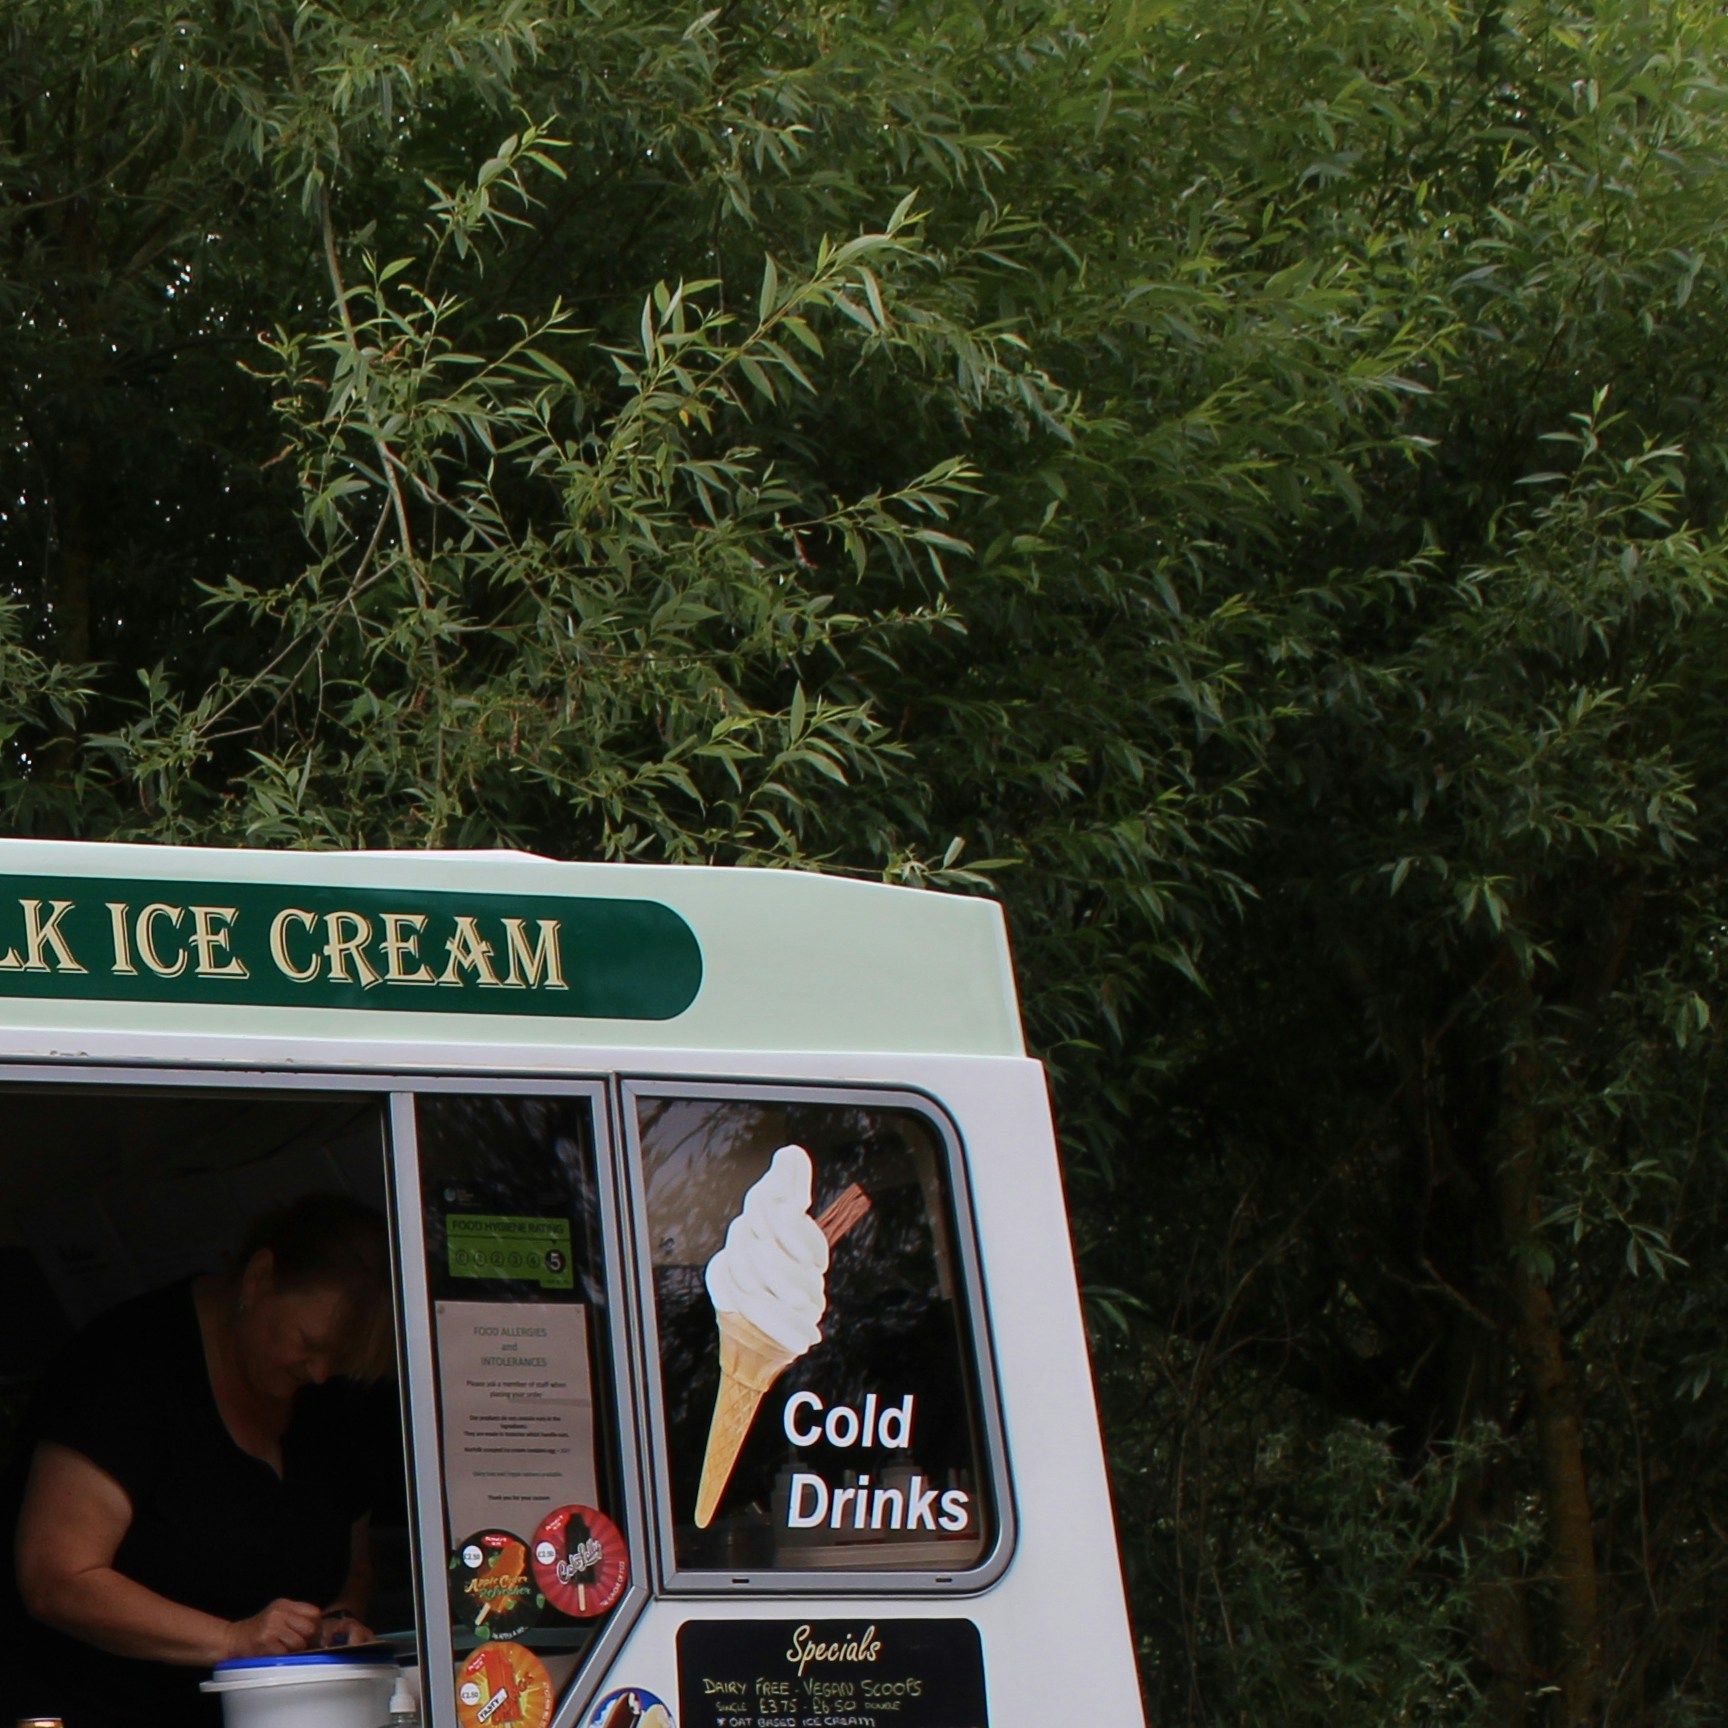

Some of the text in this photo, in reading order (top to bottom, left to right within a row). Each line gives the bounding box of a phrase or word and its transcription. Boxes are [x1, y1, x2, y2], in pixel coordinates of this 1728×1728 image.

[109, 902, 248, 980] ICE
[269, 909, 569, 992] CREAM
[452, 1220, 482, 1231] FOOD
[550, 1252, 561, 1270] 5
[474, 1326, 547, 1337] FOOD ALLERGIES
[481, 1357, 548, 1367] INTOLERANCES
[784, 1391, 914, 1448] Cold
[788, 1473, 969, 1531] Drinks
[787, 1625, 881, 1677] Specials
[703, 1678, 746, 1695] DAIRY
[756, 1677, 789, 1695] FREE
[803, 1677, 855, 1697] VEGAN
[729, 1717, 752, 1727] OAT
[802, 1717, 821, 1727] ICE
